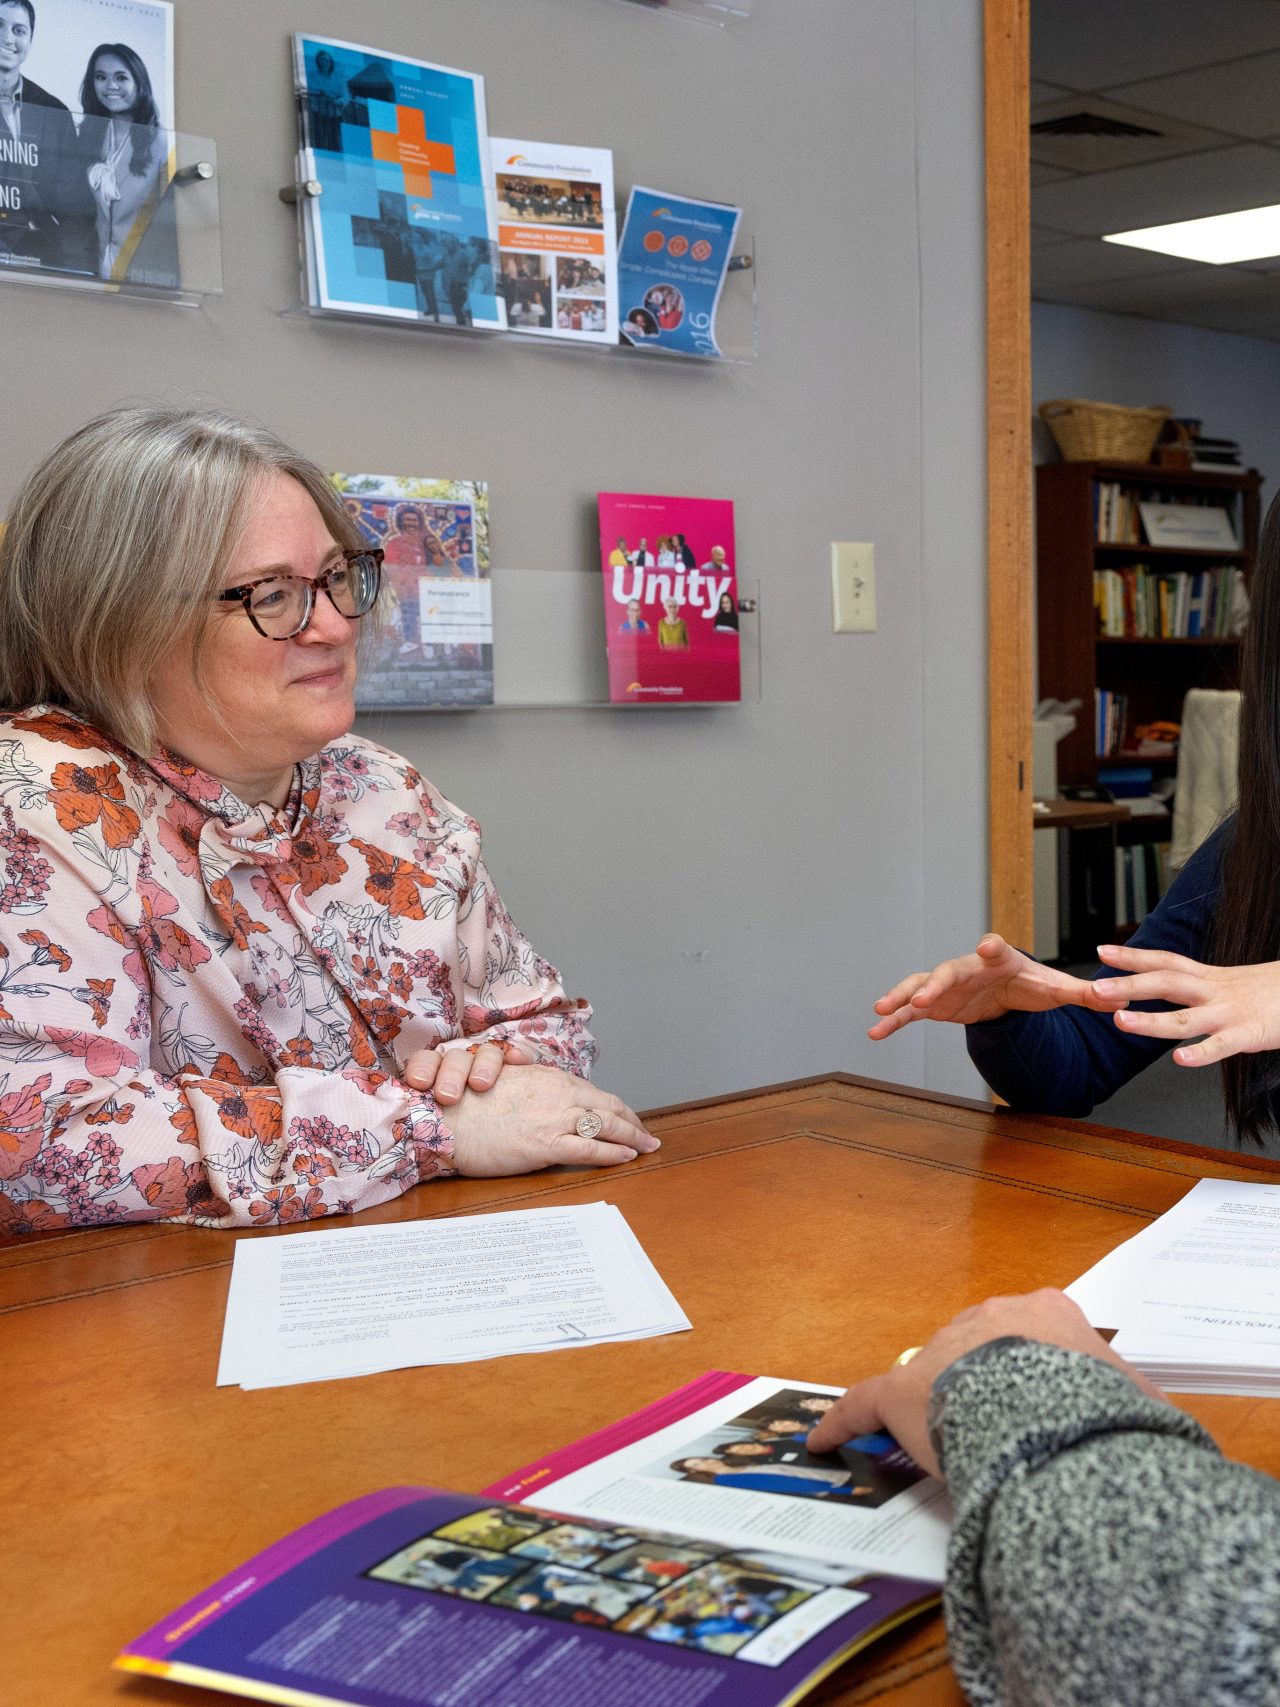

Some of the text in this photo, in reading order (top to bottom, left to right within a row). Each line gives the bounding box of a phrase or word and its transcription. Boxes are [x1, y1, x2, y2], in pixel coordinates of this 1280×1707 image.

[517, 160, 555, 171] Community
[555, 164, 592, 174] Foundation
[689, 312, 717, 356] 016
[612, 562, 733, 619] Unity
[1203, 1317, 1271, 1329] HOLSTEIN
